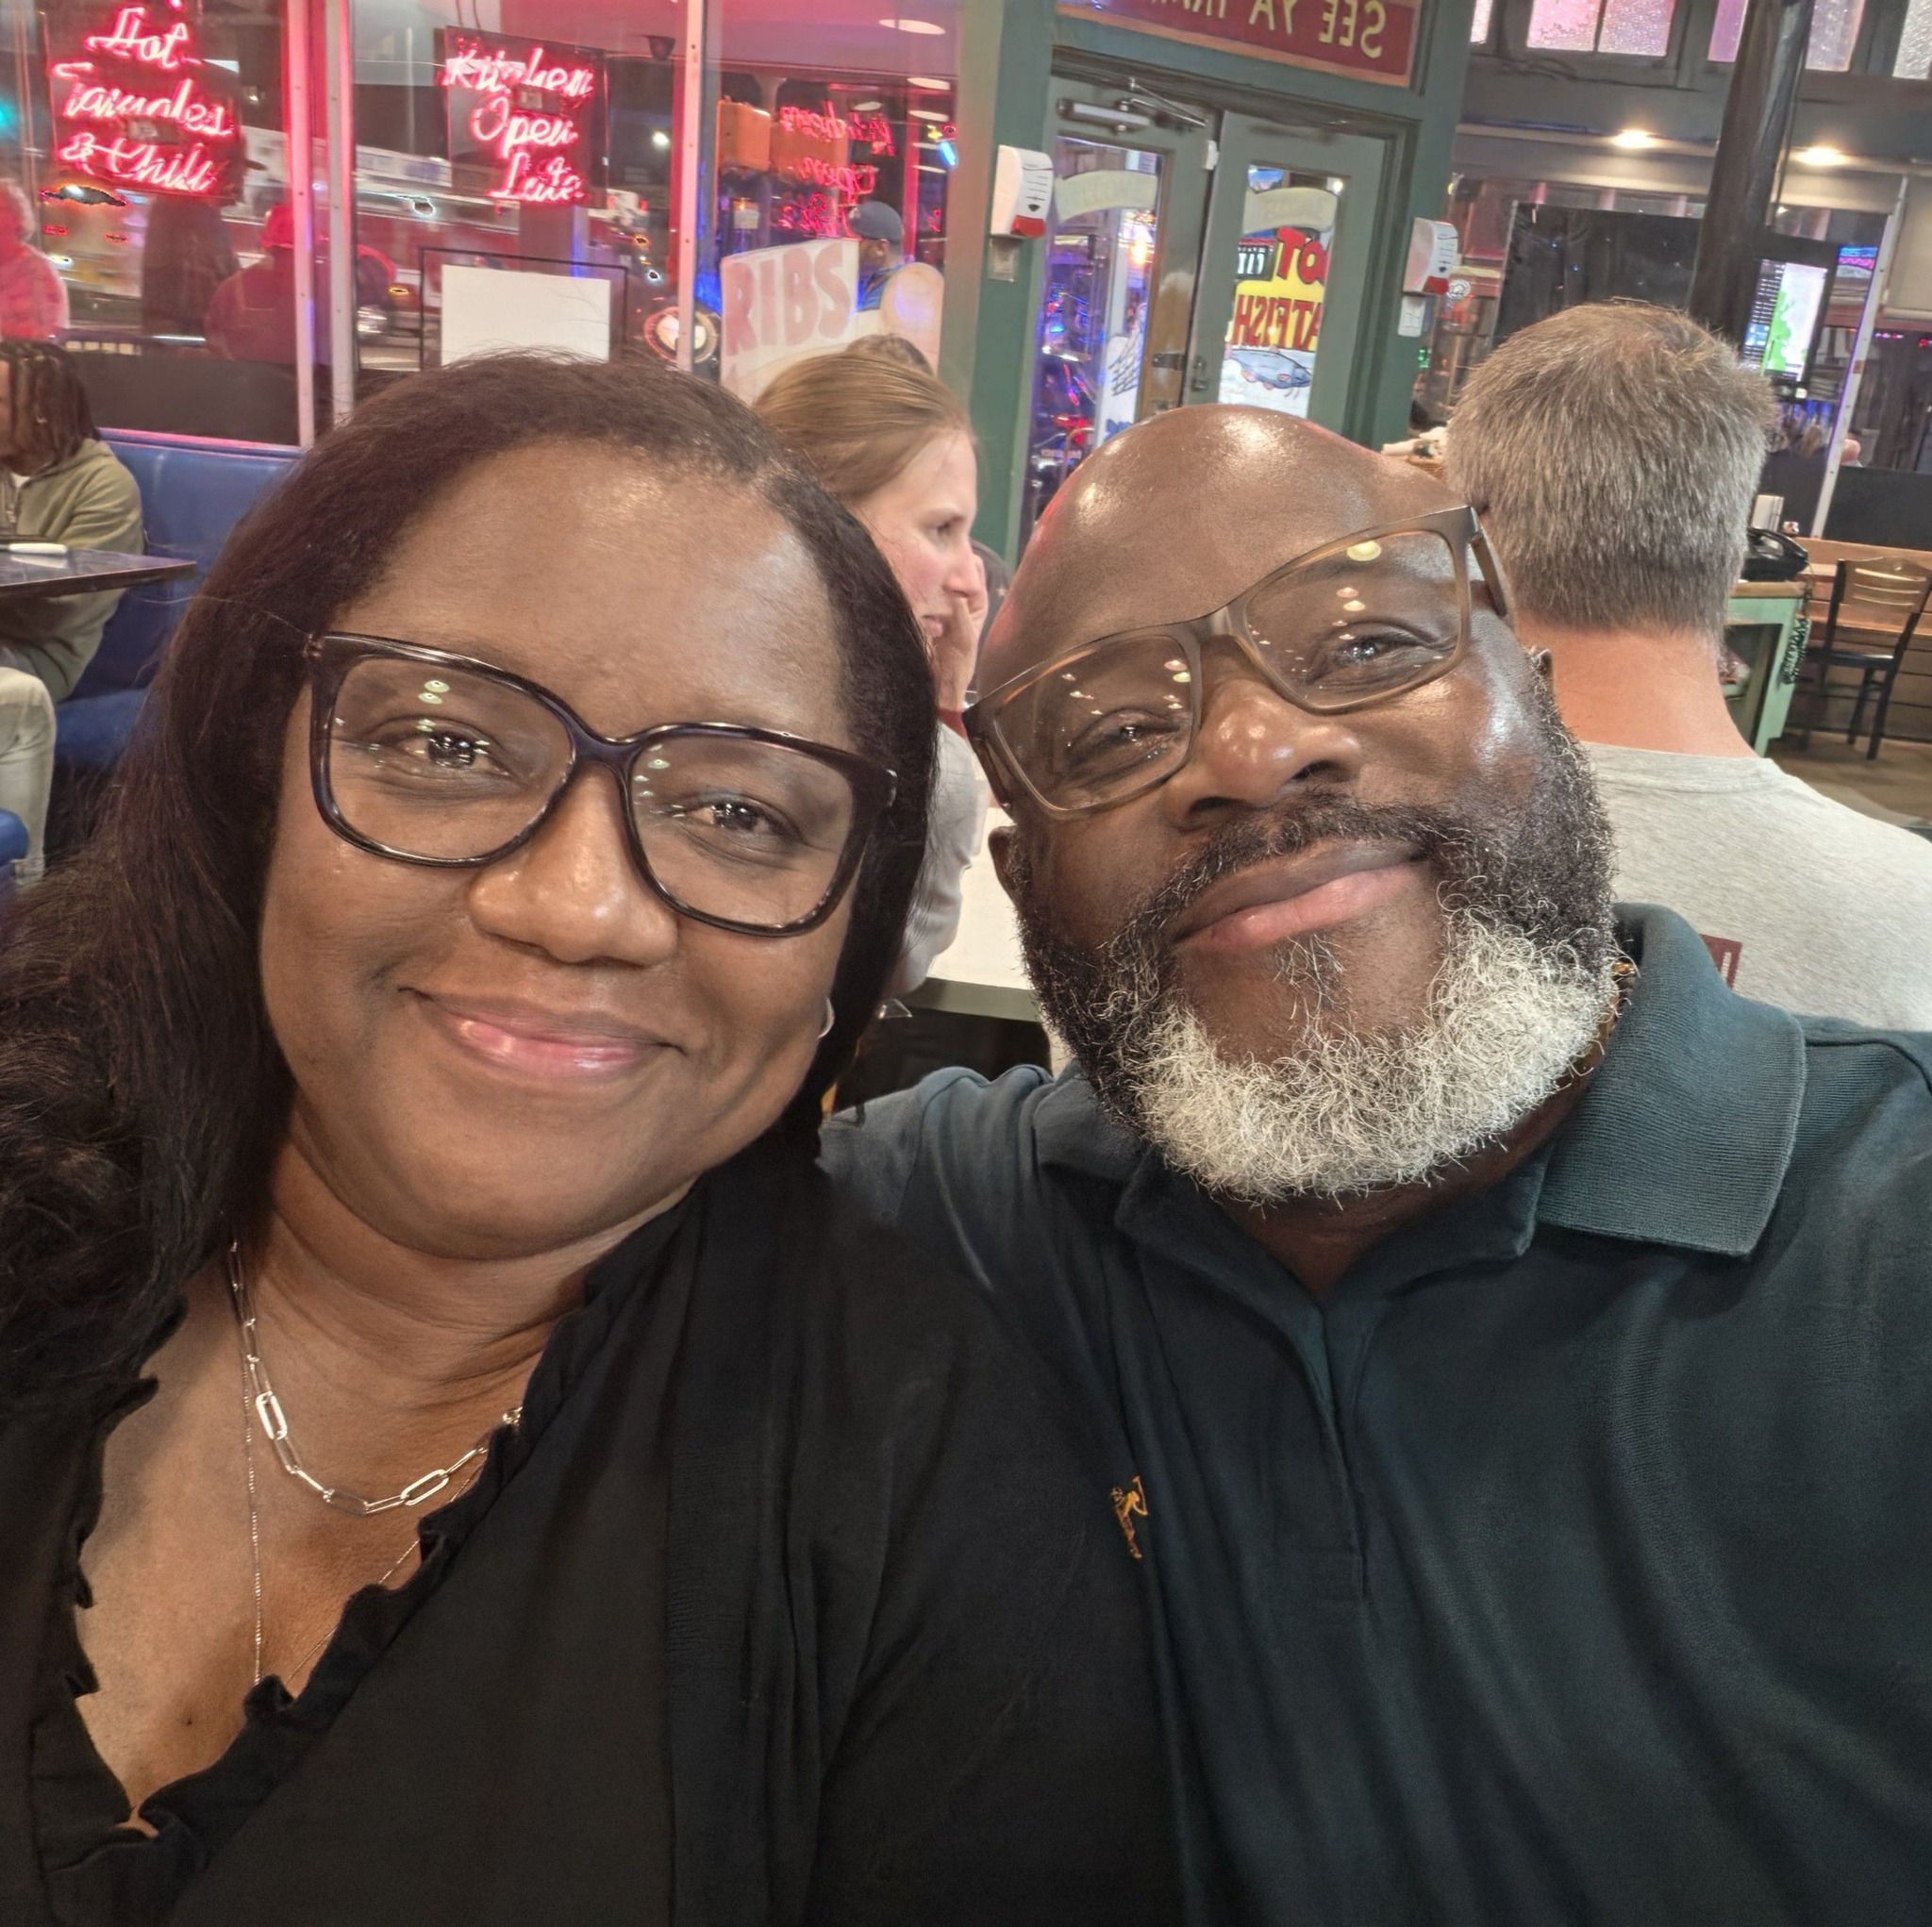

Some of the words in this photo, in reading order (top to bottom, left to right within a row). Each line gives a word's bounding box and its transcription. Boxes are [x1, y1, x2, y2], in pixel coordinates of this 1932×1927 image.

[86, 7, 189, 69] Hot
[53, 61, 235, 136] Tamales
[473, 95, 577, 158] Open
[106, 138, 218, 191] Chili
[490, 152, 585, 200] Late
[723, 243, 850, 357] RIBS
